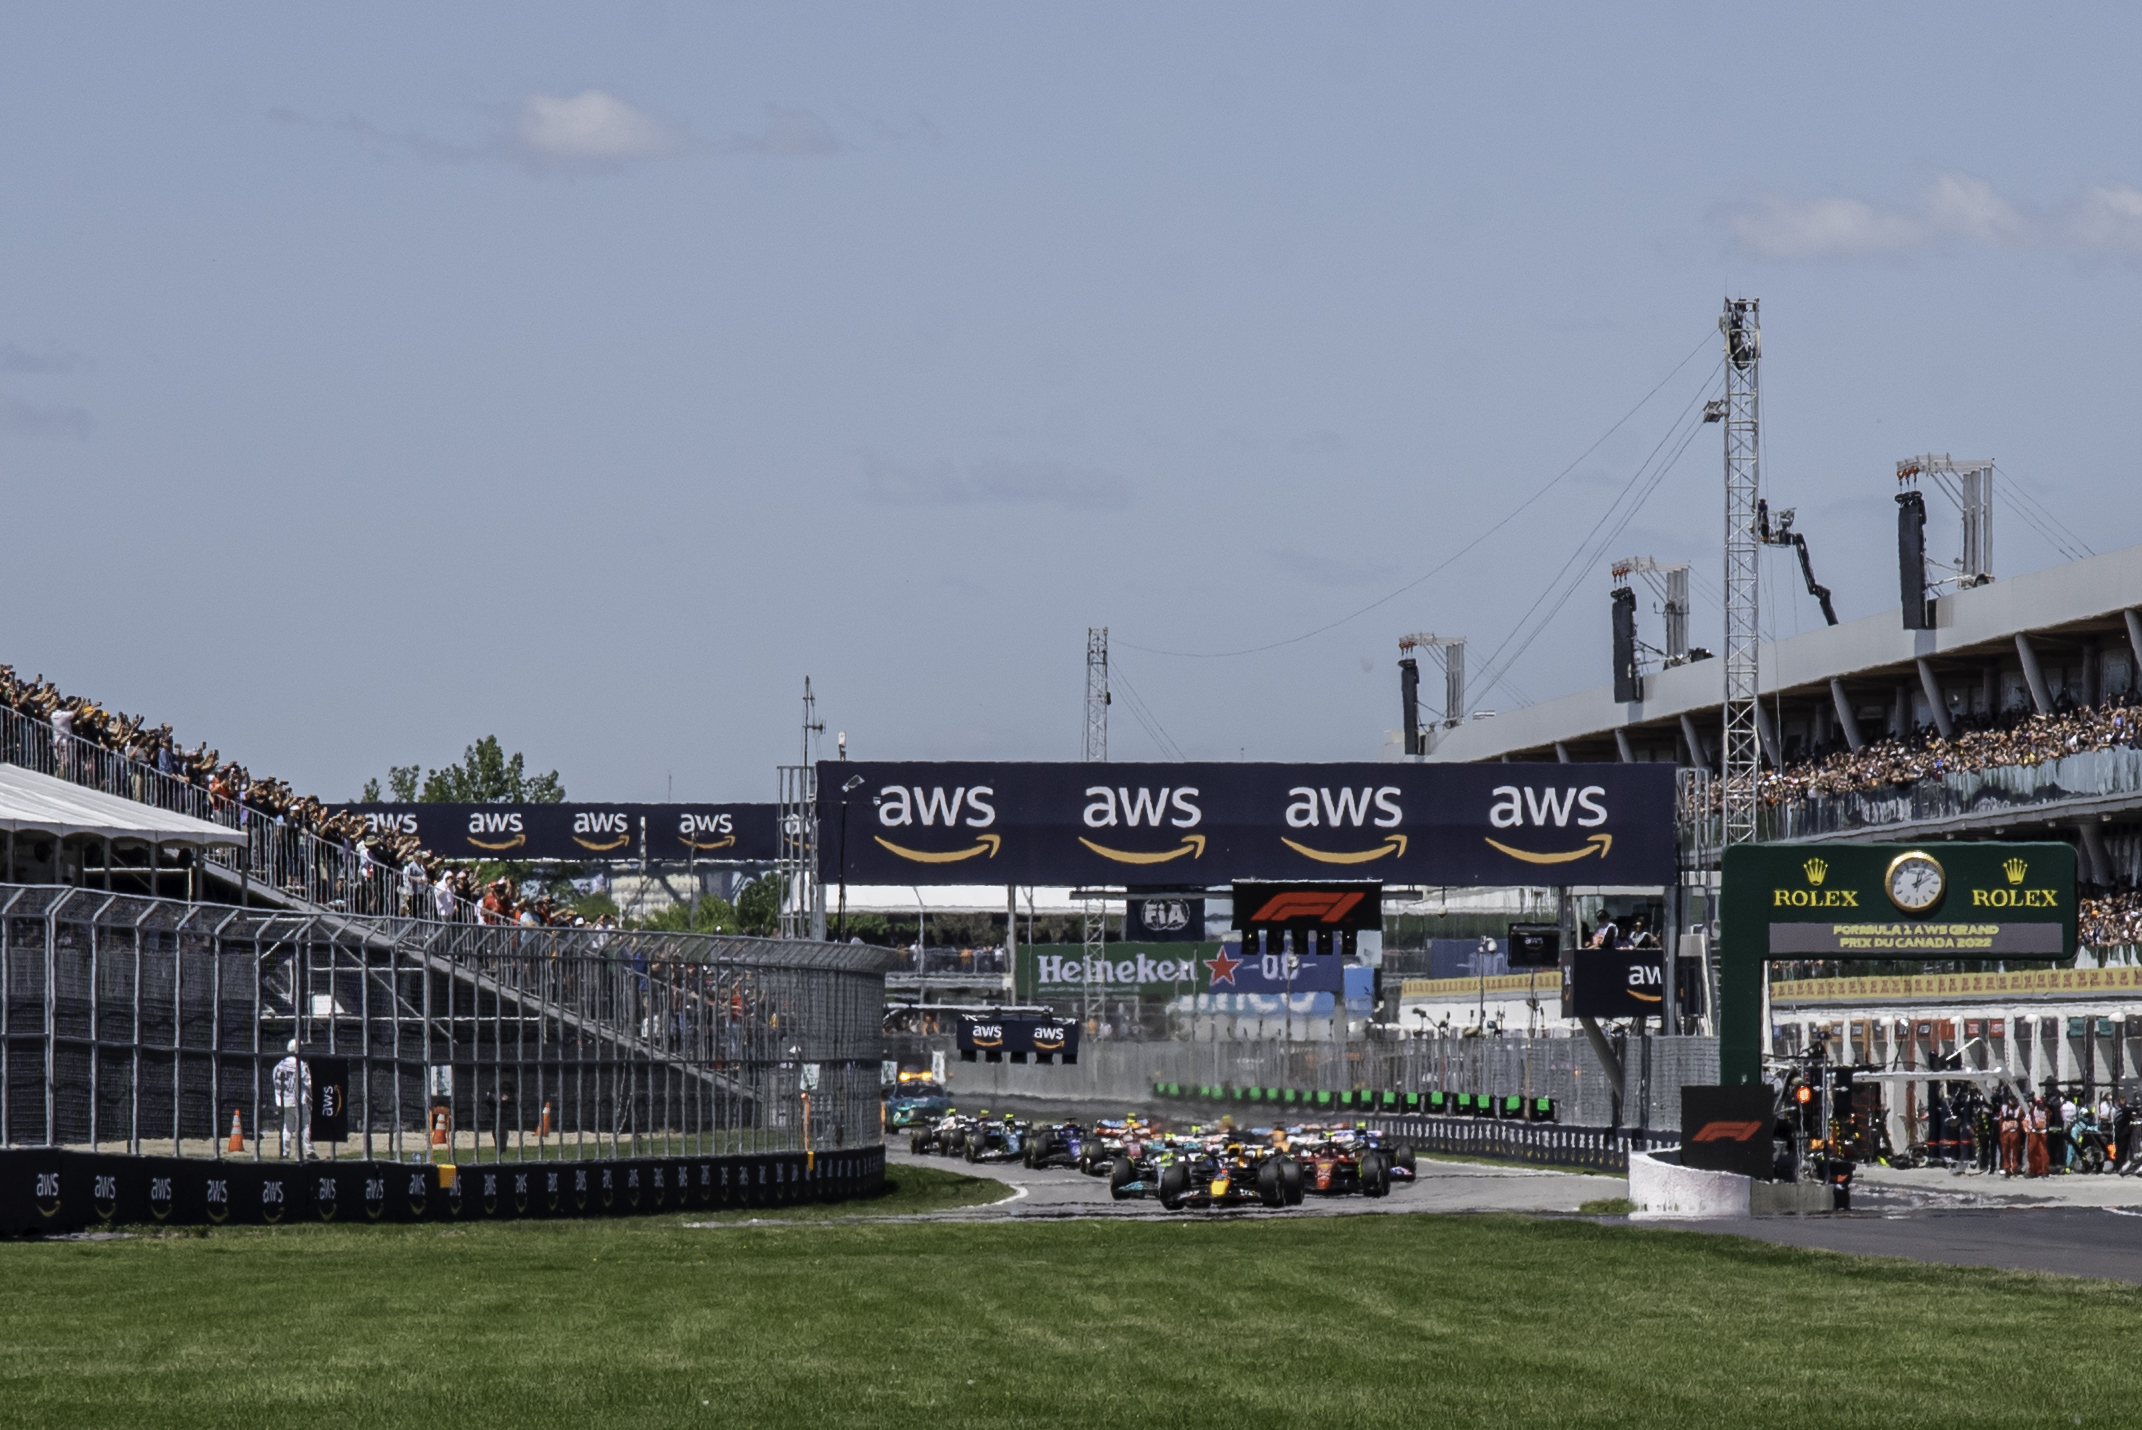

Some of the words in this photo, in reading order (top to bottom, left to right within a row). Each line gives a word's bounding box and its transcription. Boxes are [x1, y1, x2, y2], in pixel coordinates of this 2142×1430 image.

[878, 785, 996, 828] aws
[1083, 785, 1202, 828] aws
[1285, 785, 1403, 828] aws
[1489, 785, 1608, 828] aws
[468, 812, 524, 834] aws
[573, 812, 629, 833] aws
[679, 813, 733, 833] aws
[1773, 890, 1860, 907] ROLEX
[1971, 889, 2059, 907] ROLEX
[1833, 924, 1902, 935] FORMULA
[1948, 924, 2000, 935] GRAND
[1839, 937, 1872, 948] PRIX
[1873, 937, 1894, 948] DU
[1894, 937, 1955, 948] CANADA
[1956, 937, 1993, 948] 2022
[1037, 954, 1199, 984] Heineken
[1628, 965, 1664, 985] aw
[972, 1025, 1003, 1039] aws
[1034, 1027, 1064, 1040] aws
[322, 1085, 334, 1117] aws
[36, 1173, 59, 1196] aws
[94, 1175, 116, 1199] aws
[151, 1177, 172, 1200] aws
[207, 1179, 228, 1202] aws
[263, 1180, 284, 1203] aws
